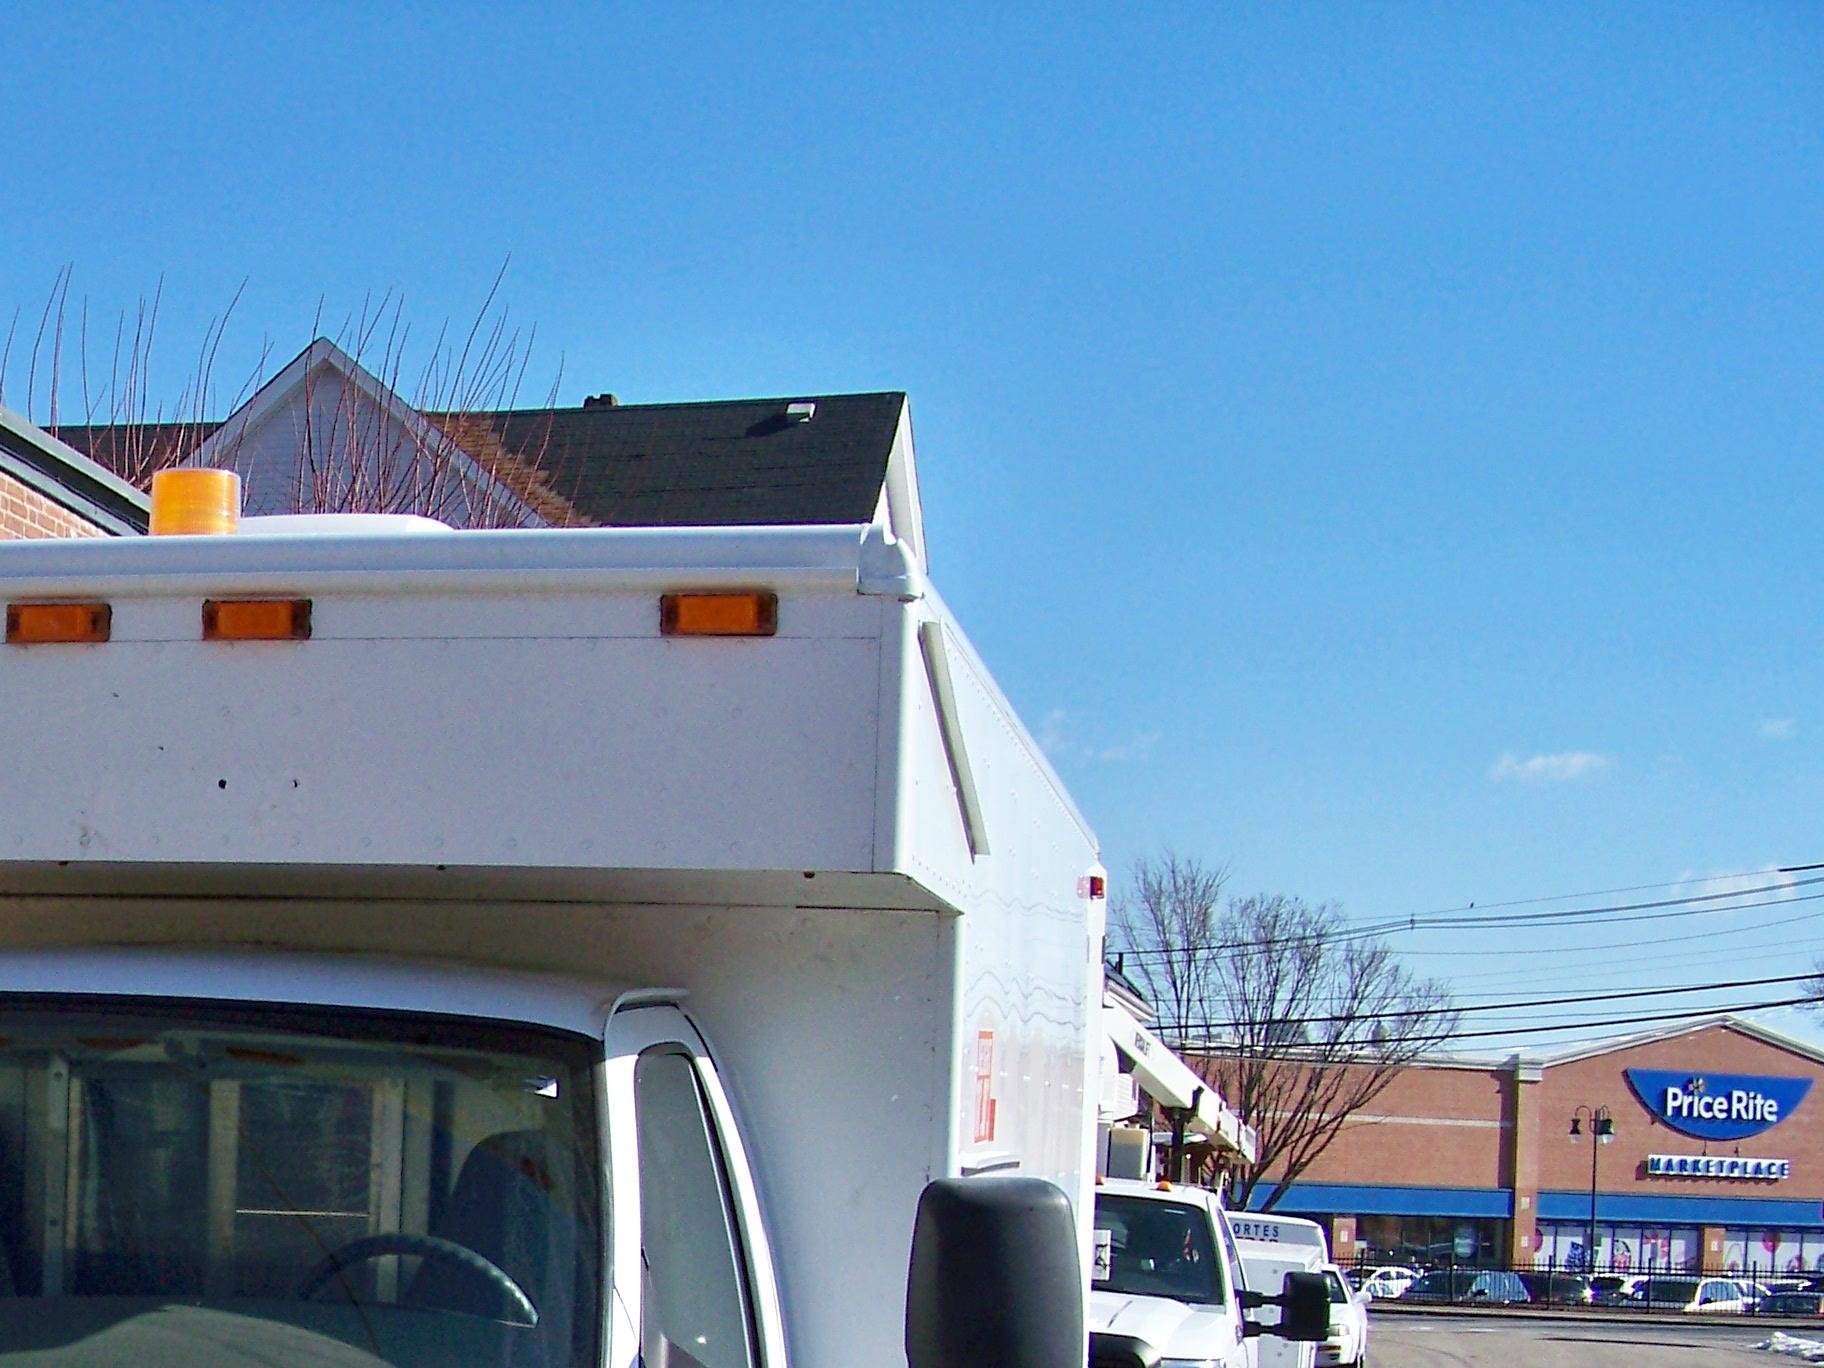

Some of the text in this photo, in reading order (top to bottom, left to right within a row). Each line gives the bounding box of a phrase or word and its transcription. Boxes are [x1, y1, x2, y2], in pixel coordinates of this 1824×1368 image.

[1666, 1086, 1778, 1122] Price Rite
[1650, 1157, 1789, 1177] MARKETPLACE
[1233, 1223, 1279, 1237] ORTES
